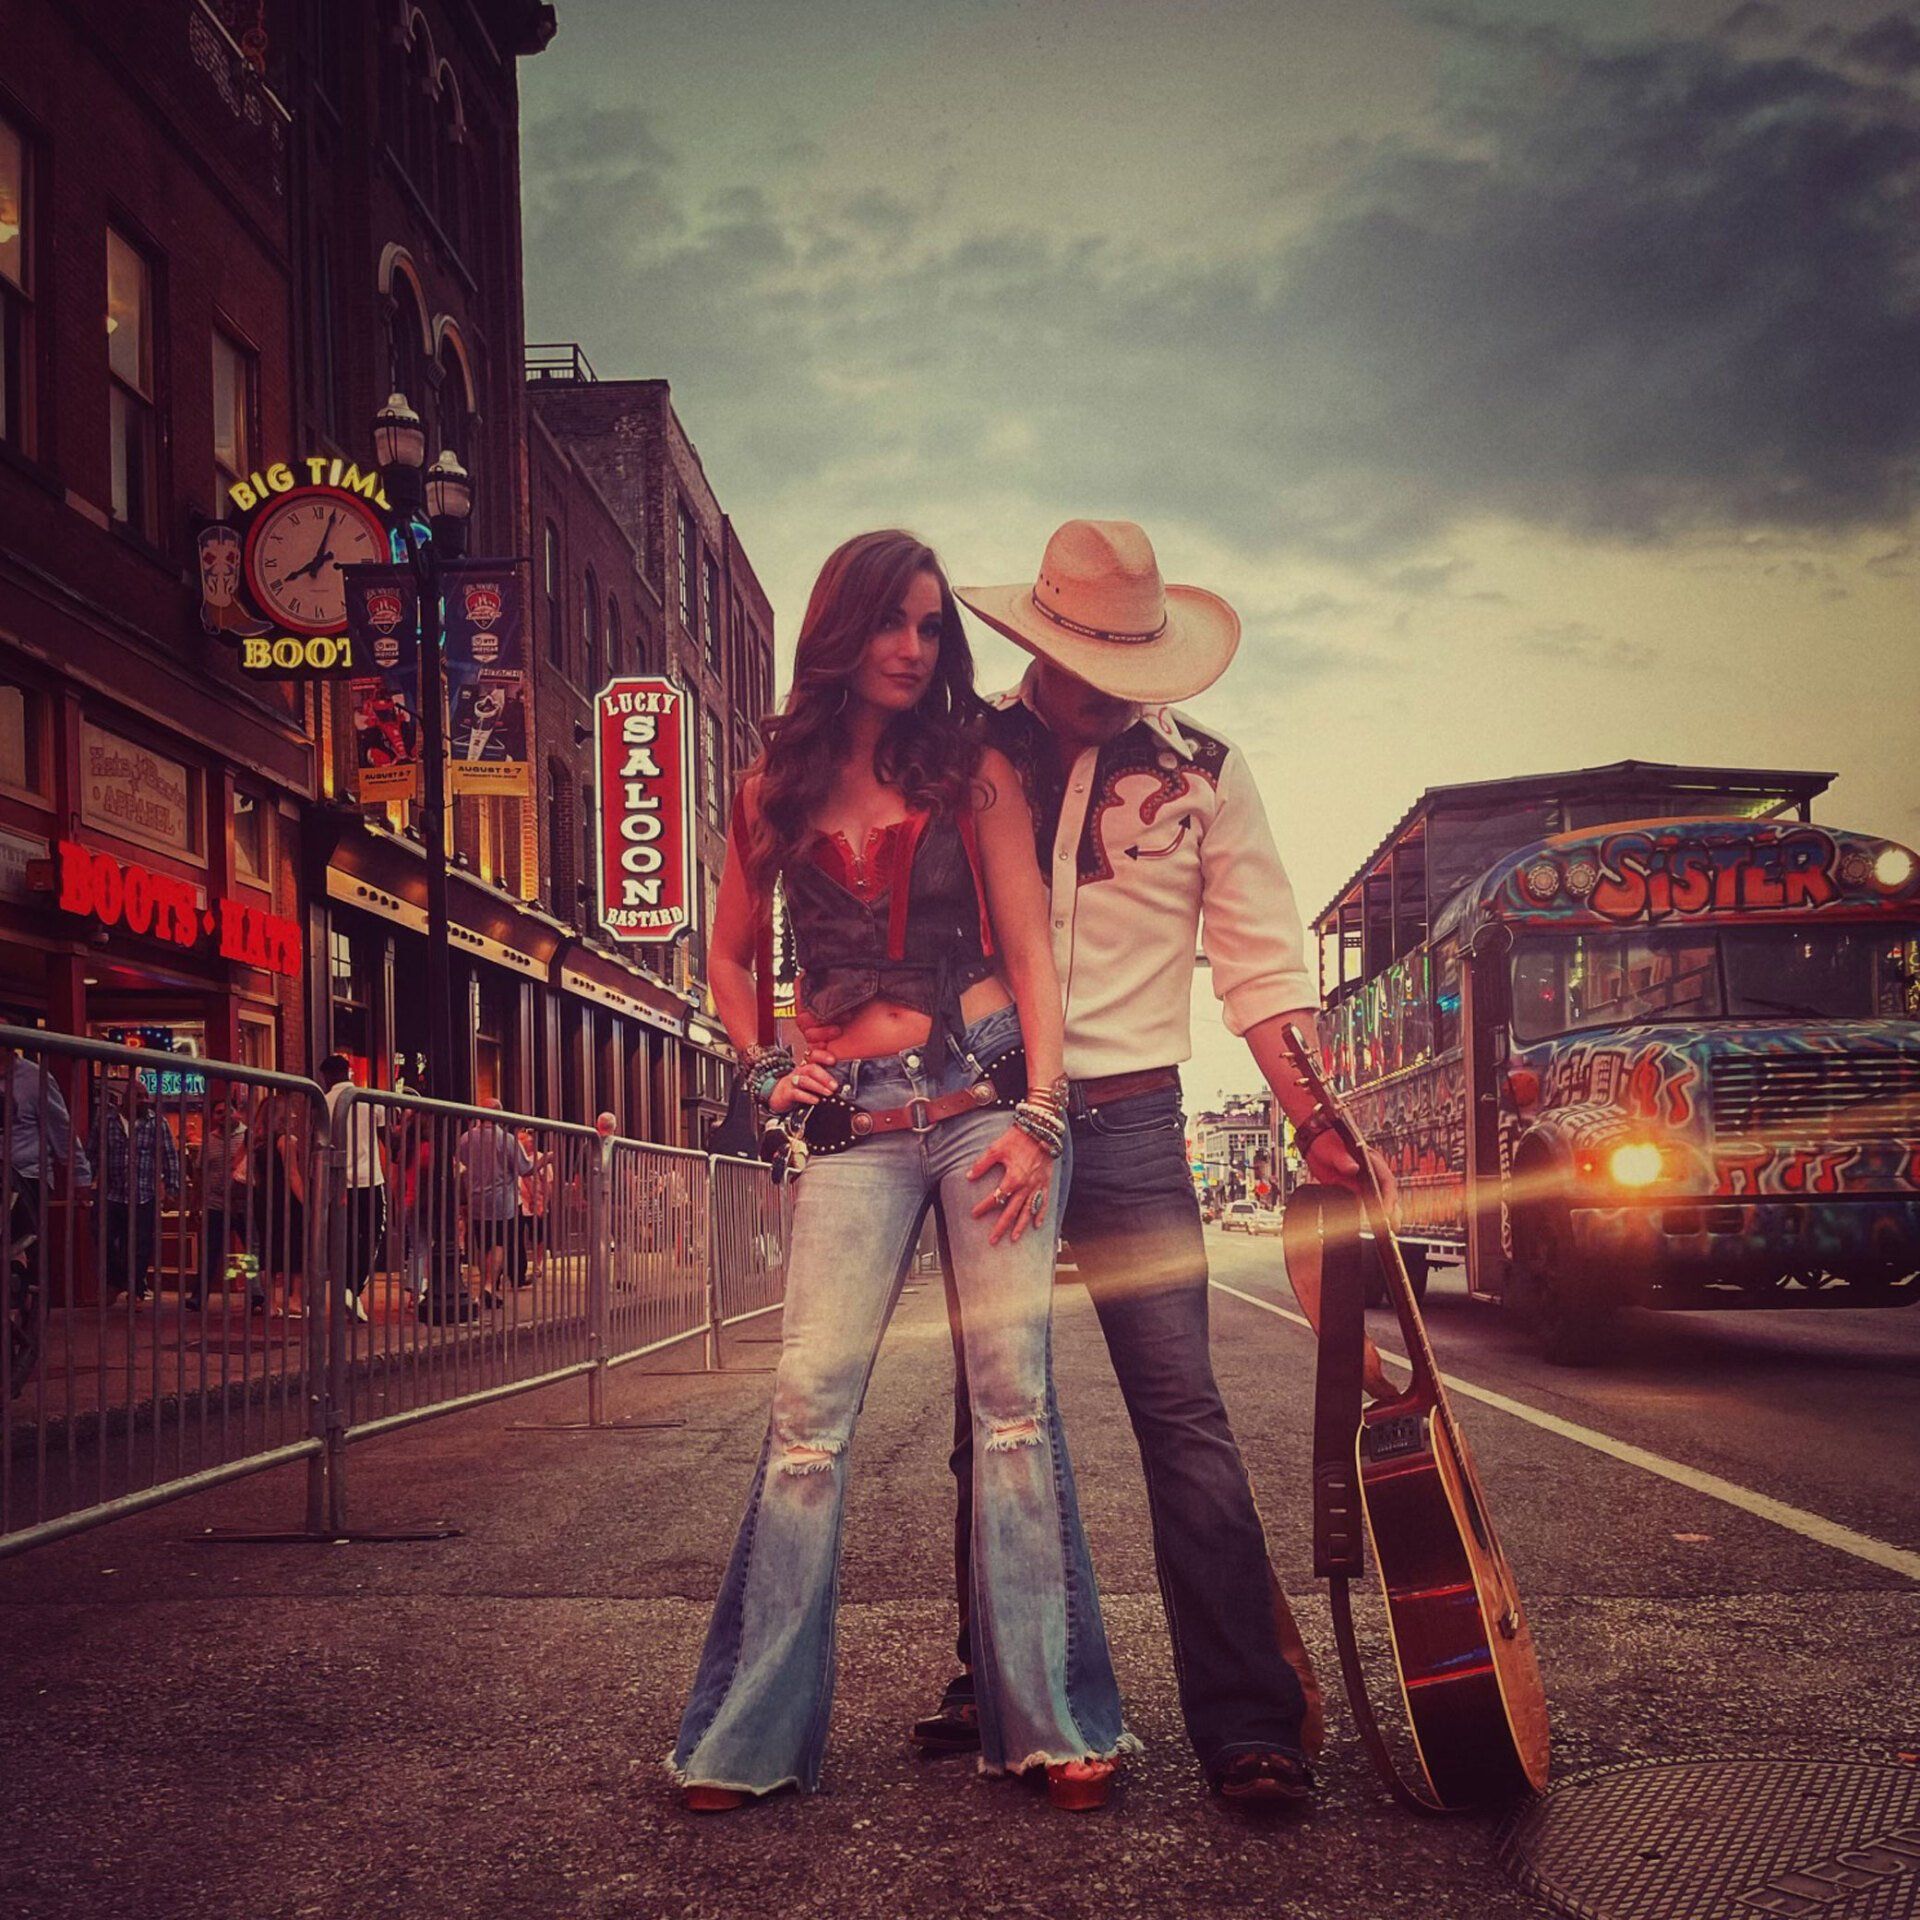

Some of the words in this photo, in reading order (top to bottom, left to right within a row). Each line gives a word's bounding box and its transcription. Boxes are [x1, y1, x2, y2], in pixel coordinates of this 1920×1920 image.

[229, 462, 295, 511] BIG
[603, 691, 677, 716] LUCKY
[458, 766, 501, 774] AUGUST
[619, 715, 662, 905] SALOON
[58, 839, 198, 948] BOOTS
[219, 897, 303, 977] HATS
[606, 905, 684, 928] BASTARD
